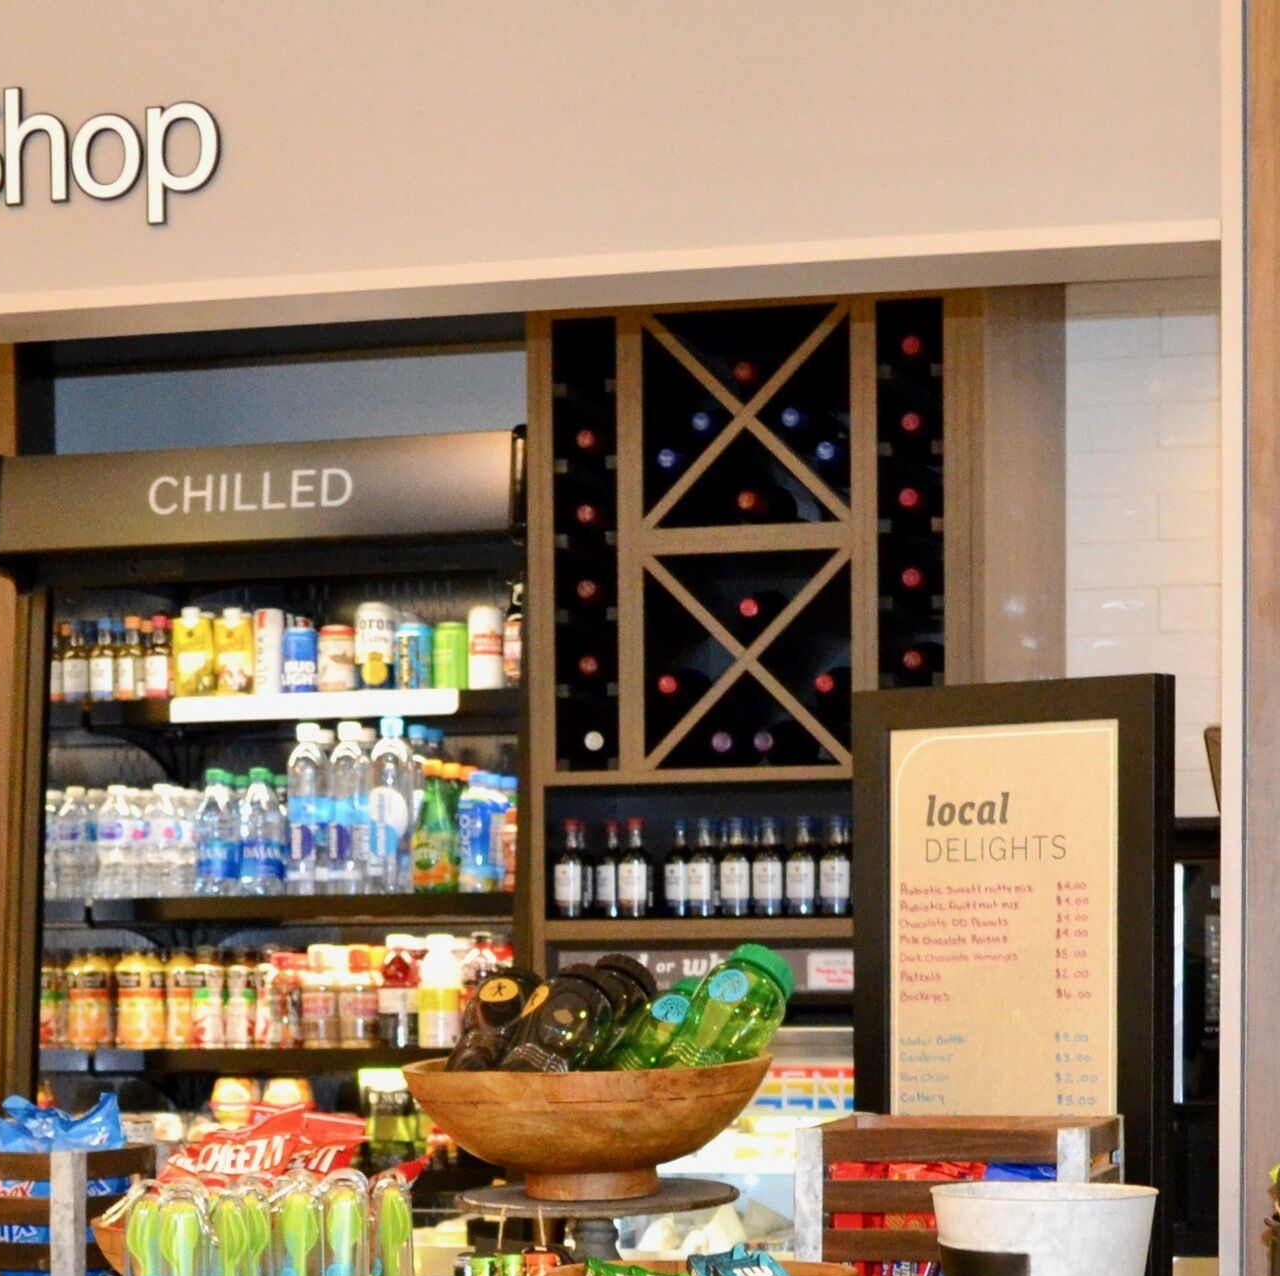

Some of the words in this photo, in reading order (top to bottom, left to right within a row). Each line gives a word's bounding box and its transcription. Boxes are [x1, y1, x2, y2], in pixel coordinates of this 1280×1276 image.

[149, 469, 352, 515] CHILLED
[926, 792, 1010, 827] local
[925, 834, 1067, 863] DELIGHTS
[656, 960, 676, 973] or
[1055, 969, 1089, 979] $2.00
